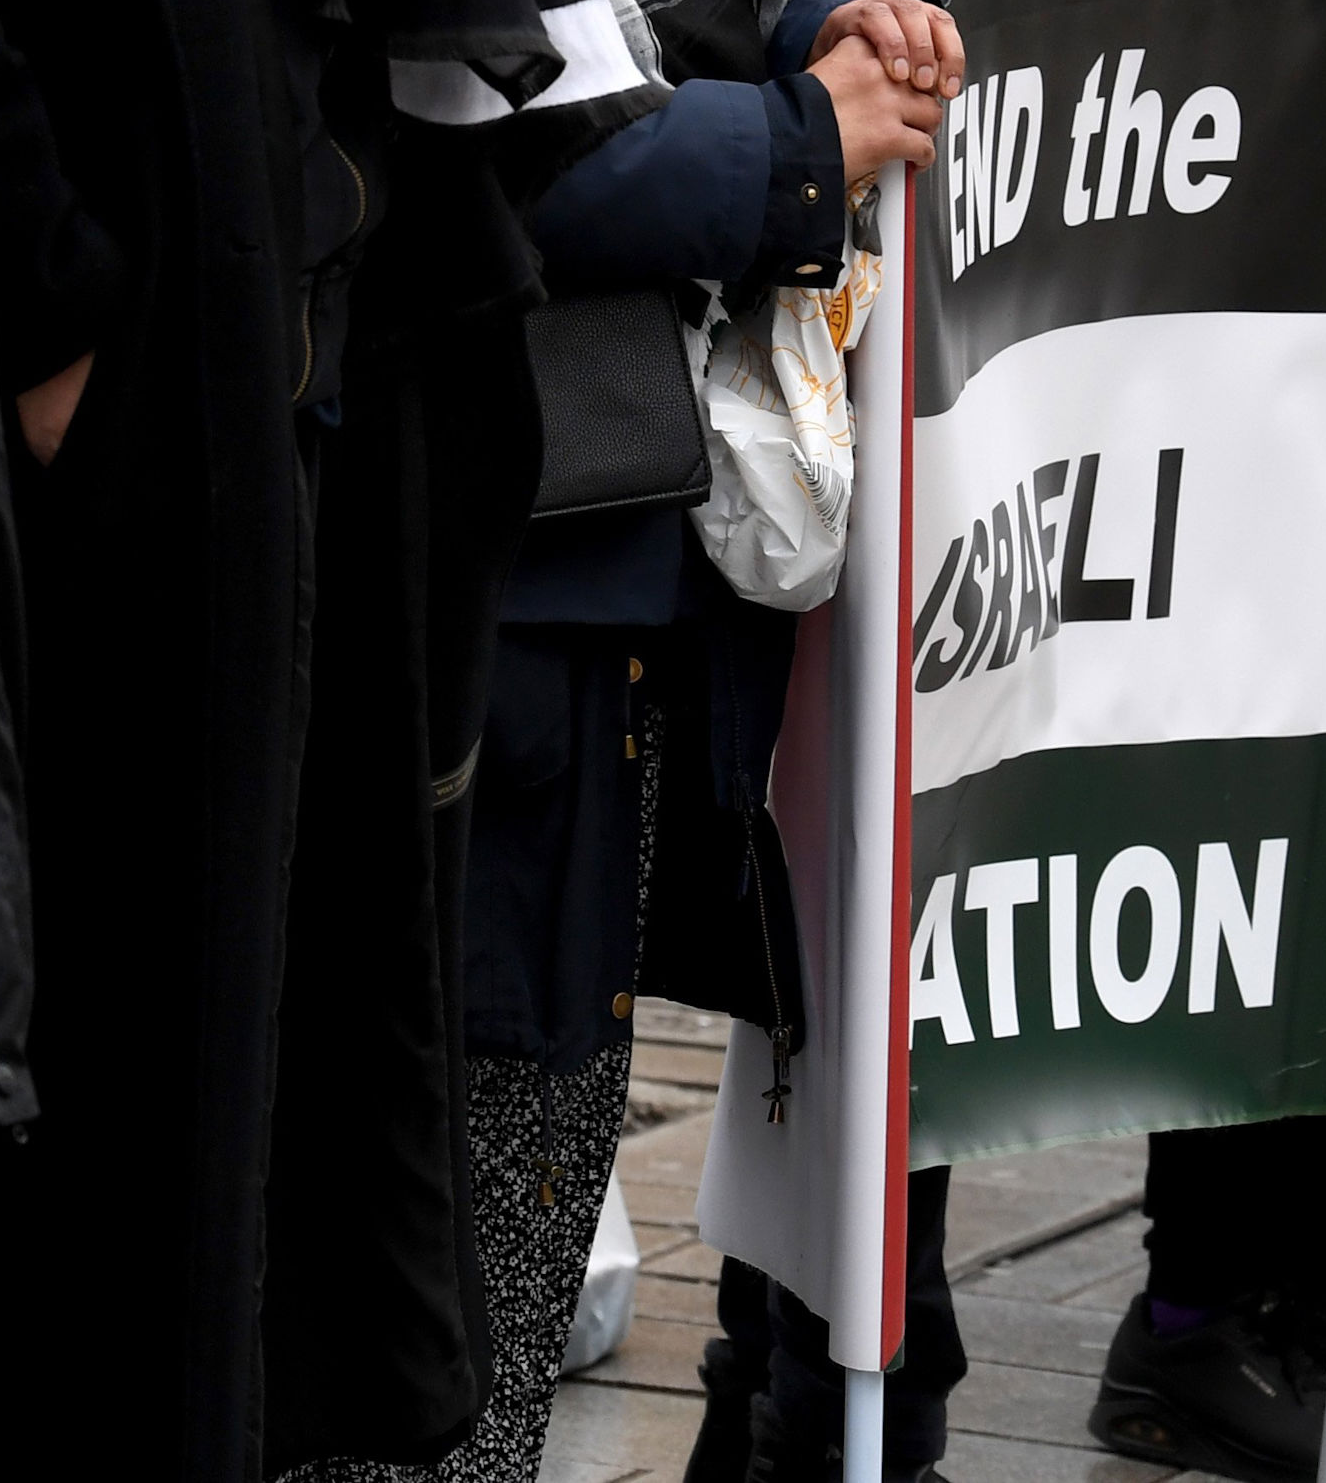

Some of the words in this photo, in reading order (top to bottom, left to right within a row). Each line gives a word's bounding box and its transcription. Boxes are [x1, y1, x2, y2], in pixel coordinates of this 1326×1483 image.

[947, 65, 1043, 283] END
[1063, 48, 1241, 227] the
[912, 448, 1185, 693] ISRAELI
[909, 838, 1289, 1051] ATION
